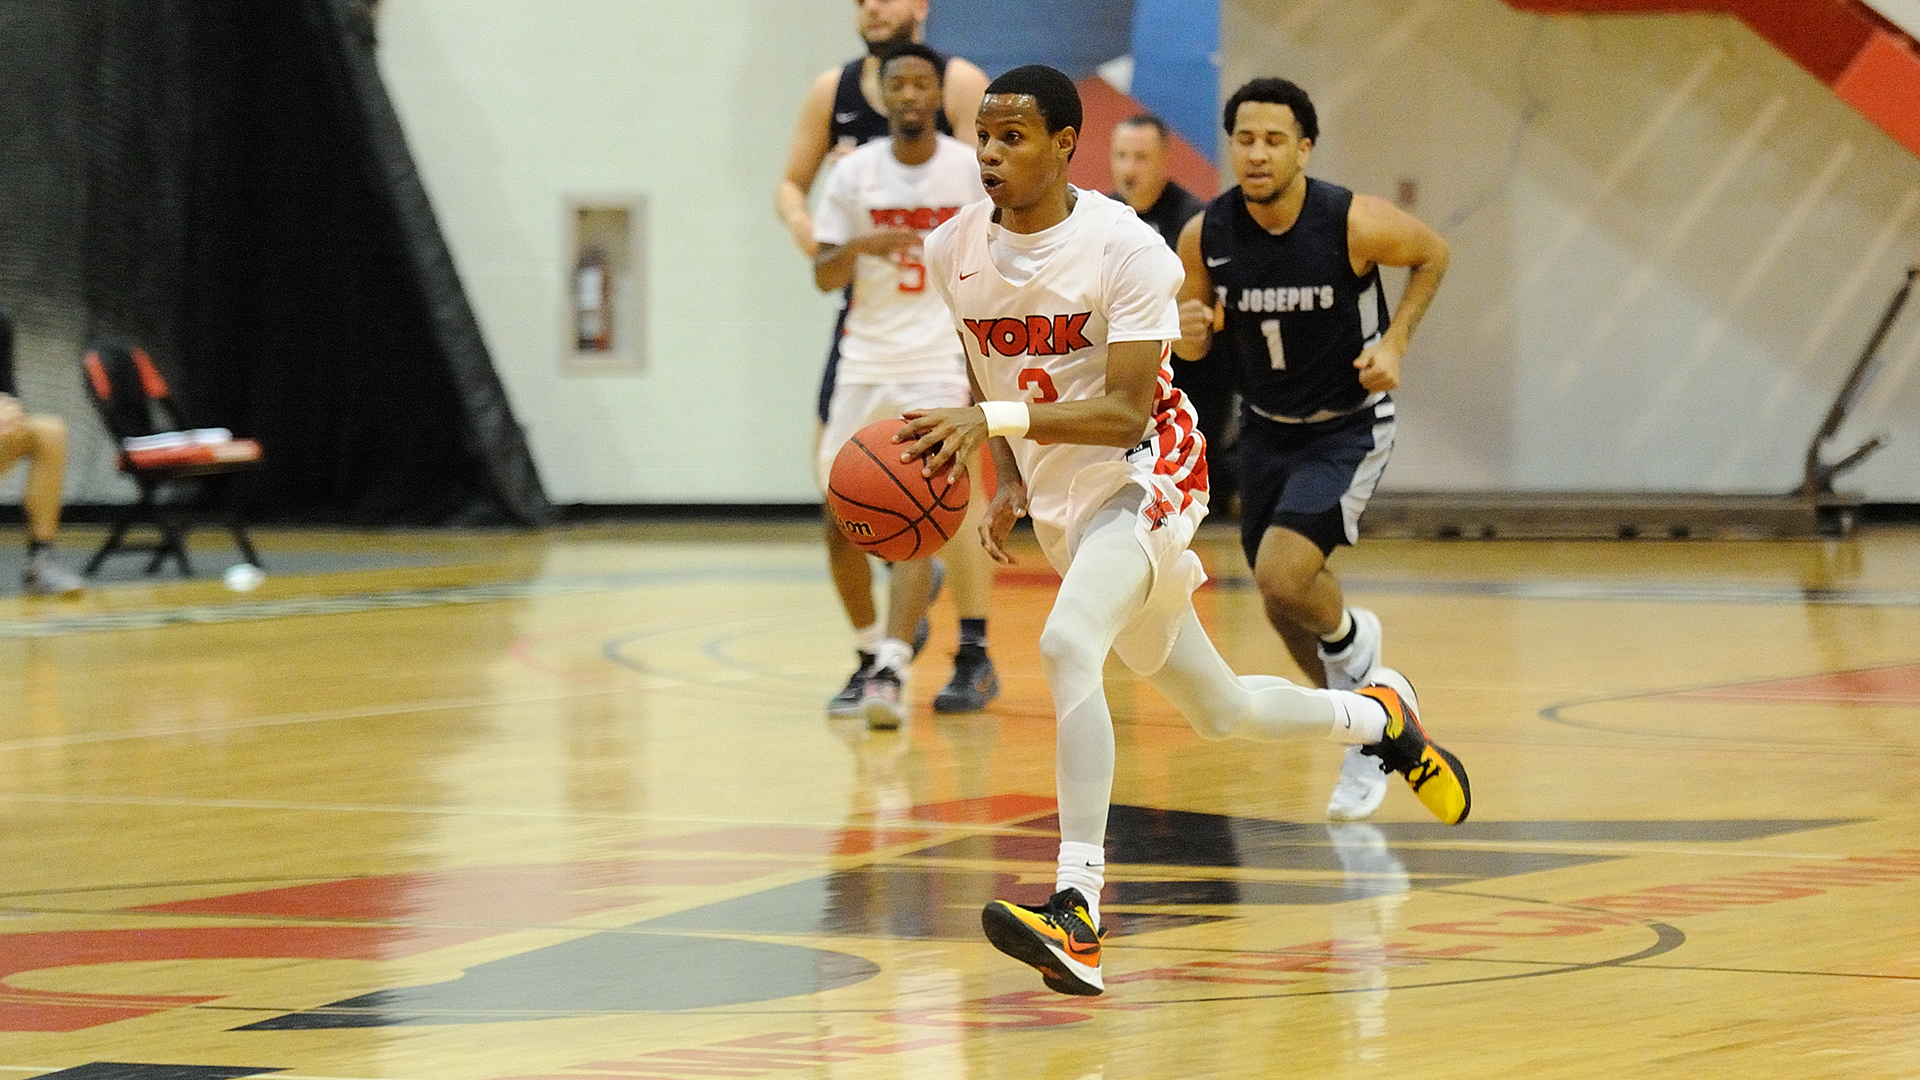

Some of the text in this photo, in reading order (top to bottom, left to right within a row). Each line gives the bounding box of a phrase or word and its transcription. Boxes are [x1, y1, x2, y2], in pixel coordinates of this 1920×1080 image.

[1238, 285, 1334, 312] JOSEPH'S
[962, 311, 1094, 358] YORK
[1261, 320, 1286, 370] 1
